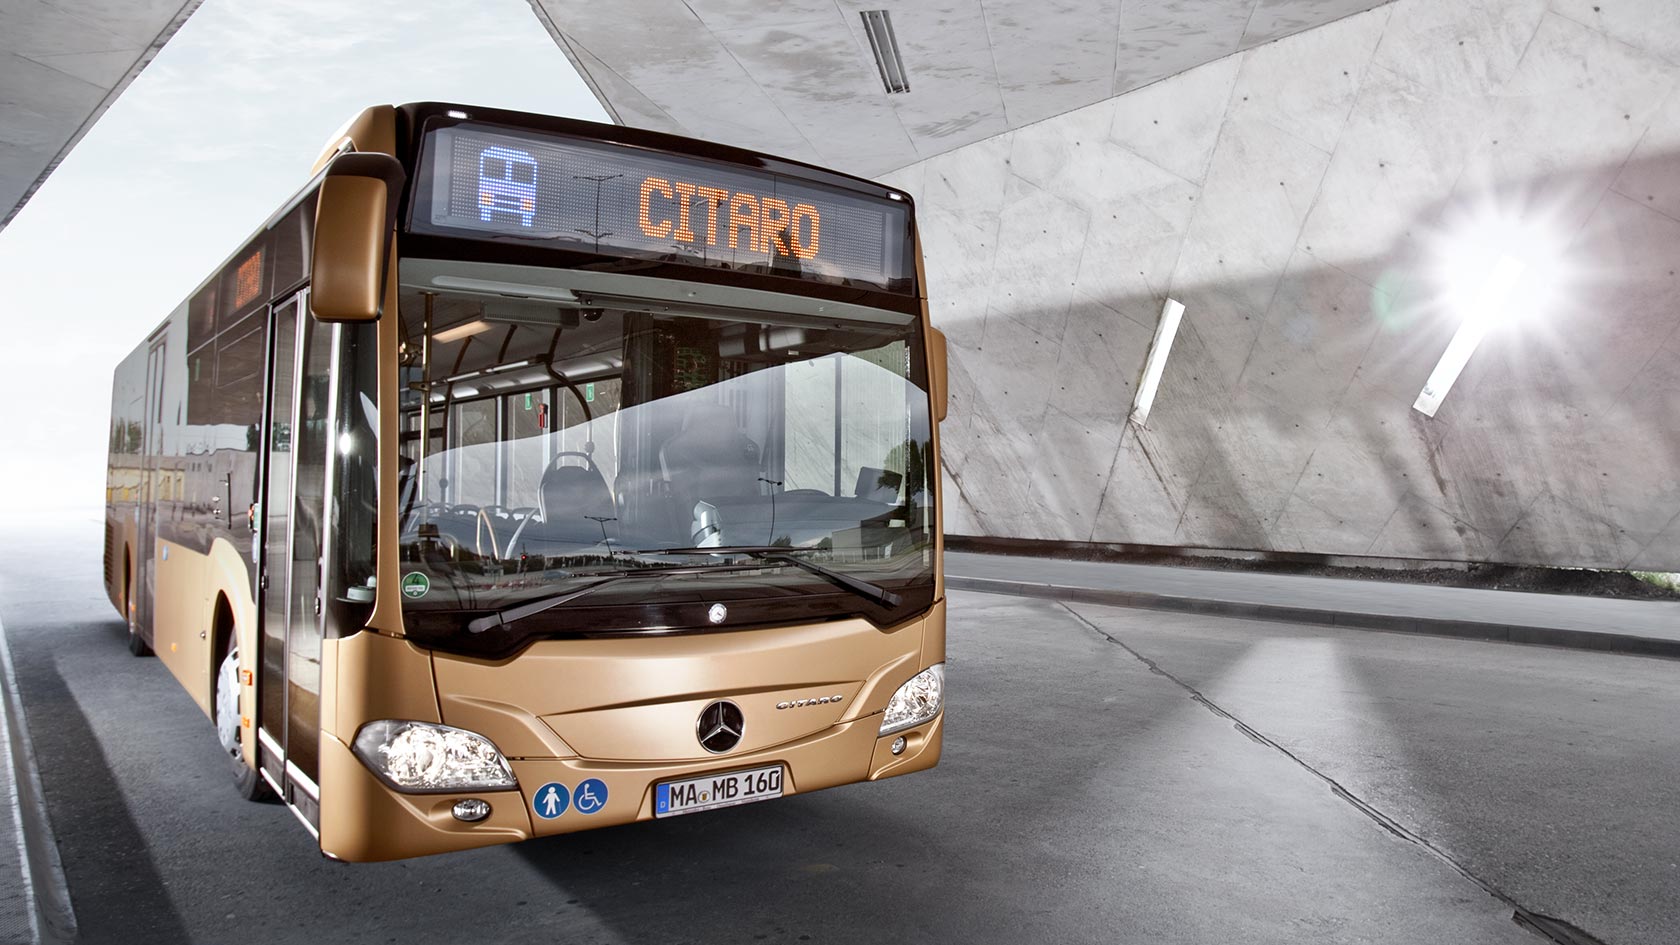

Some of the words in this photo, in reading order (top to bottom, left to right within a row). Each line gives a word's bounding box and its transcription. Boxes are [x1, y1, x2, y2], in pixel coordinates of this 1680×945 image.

[639, 178, 820, 259] CITARO
[776, 694, 843, 710] CITARO
[670, 783, 698, 808] MA
[712, 777, 739, 801] MB
[743, 770, 780, 796] 160
